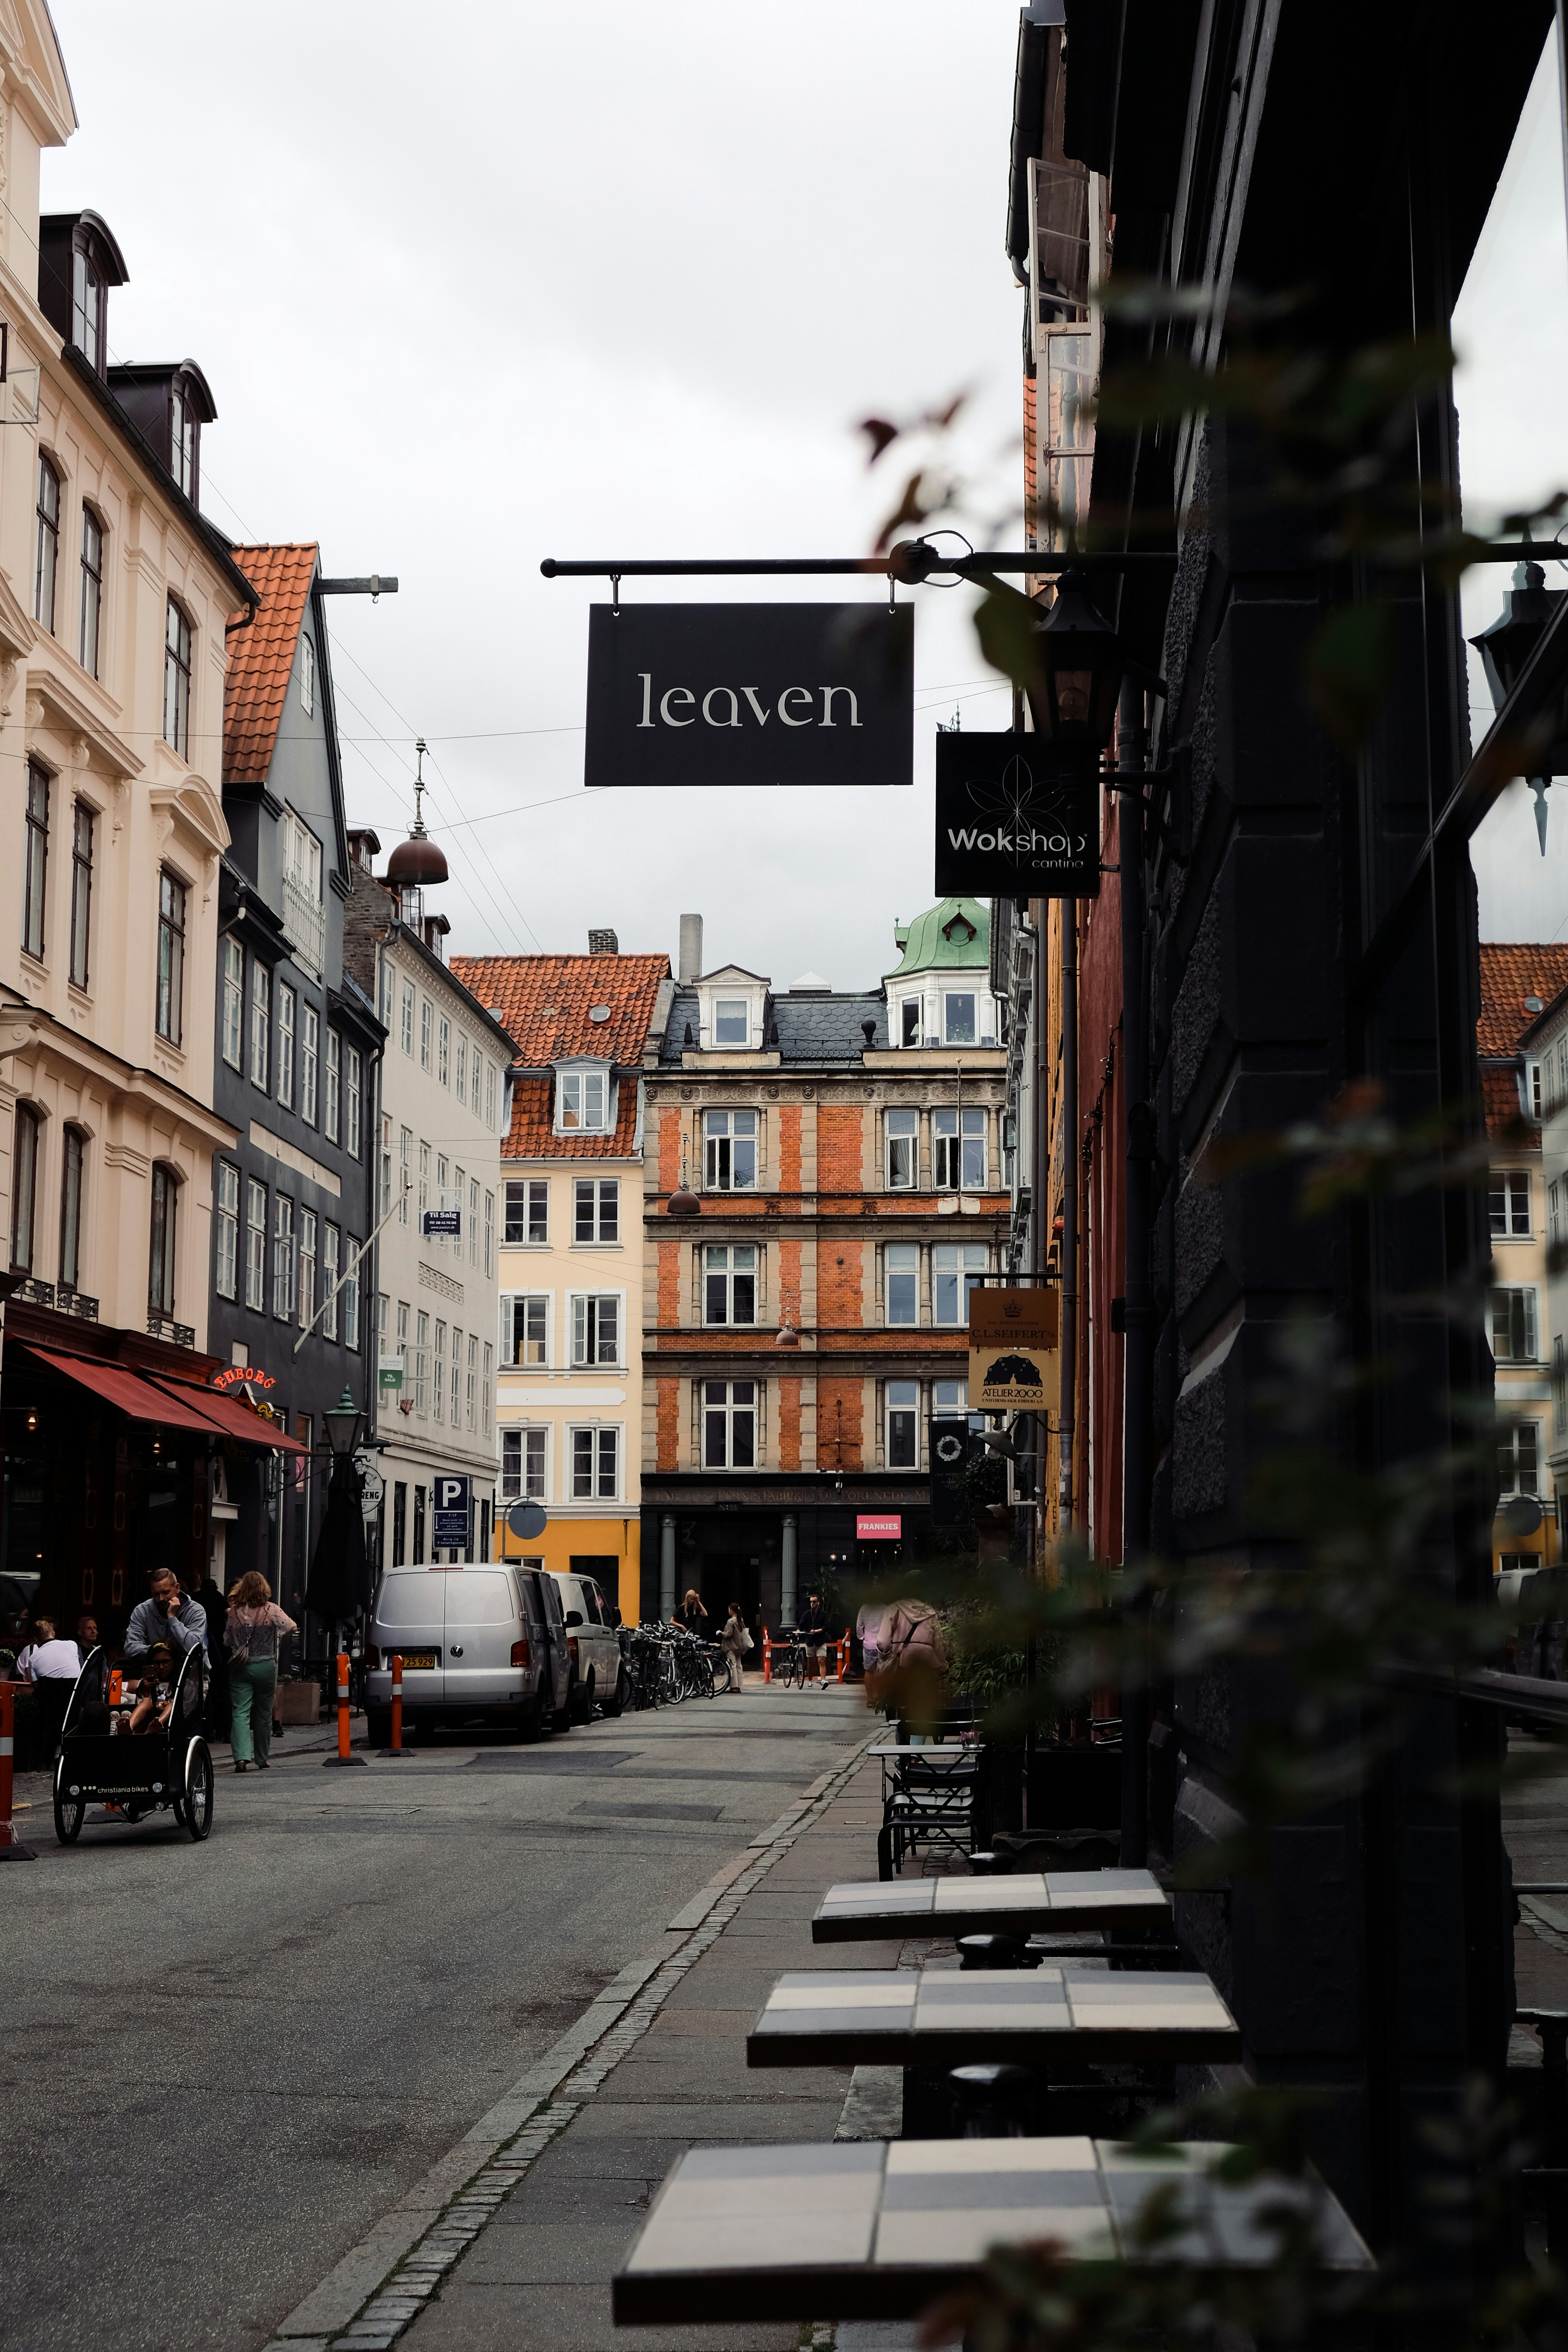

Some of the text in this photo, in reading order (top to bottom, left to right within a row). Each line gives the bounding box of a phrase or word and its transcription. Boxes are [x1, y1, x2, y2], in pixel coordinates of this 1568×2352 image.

[636, 673, 863, 727] leaven
[947, 827, 1085, 858] Wokshop
[1032, 858, 1084, 868] cantina
[214, 1367, 276, 1389] TUBORG
[982, 1388, 1043, 1398] ATELIER 2000
[442, 1481, 461, 1507] P
[841, 1490, 907, 1500] FORENEDE
[406, 1658, 416, 1666] 25
[418, 1658, 433, 1666] 929
